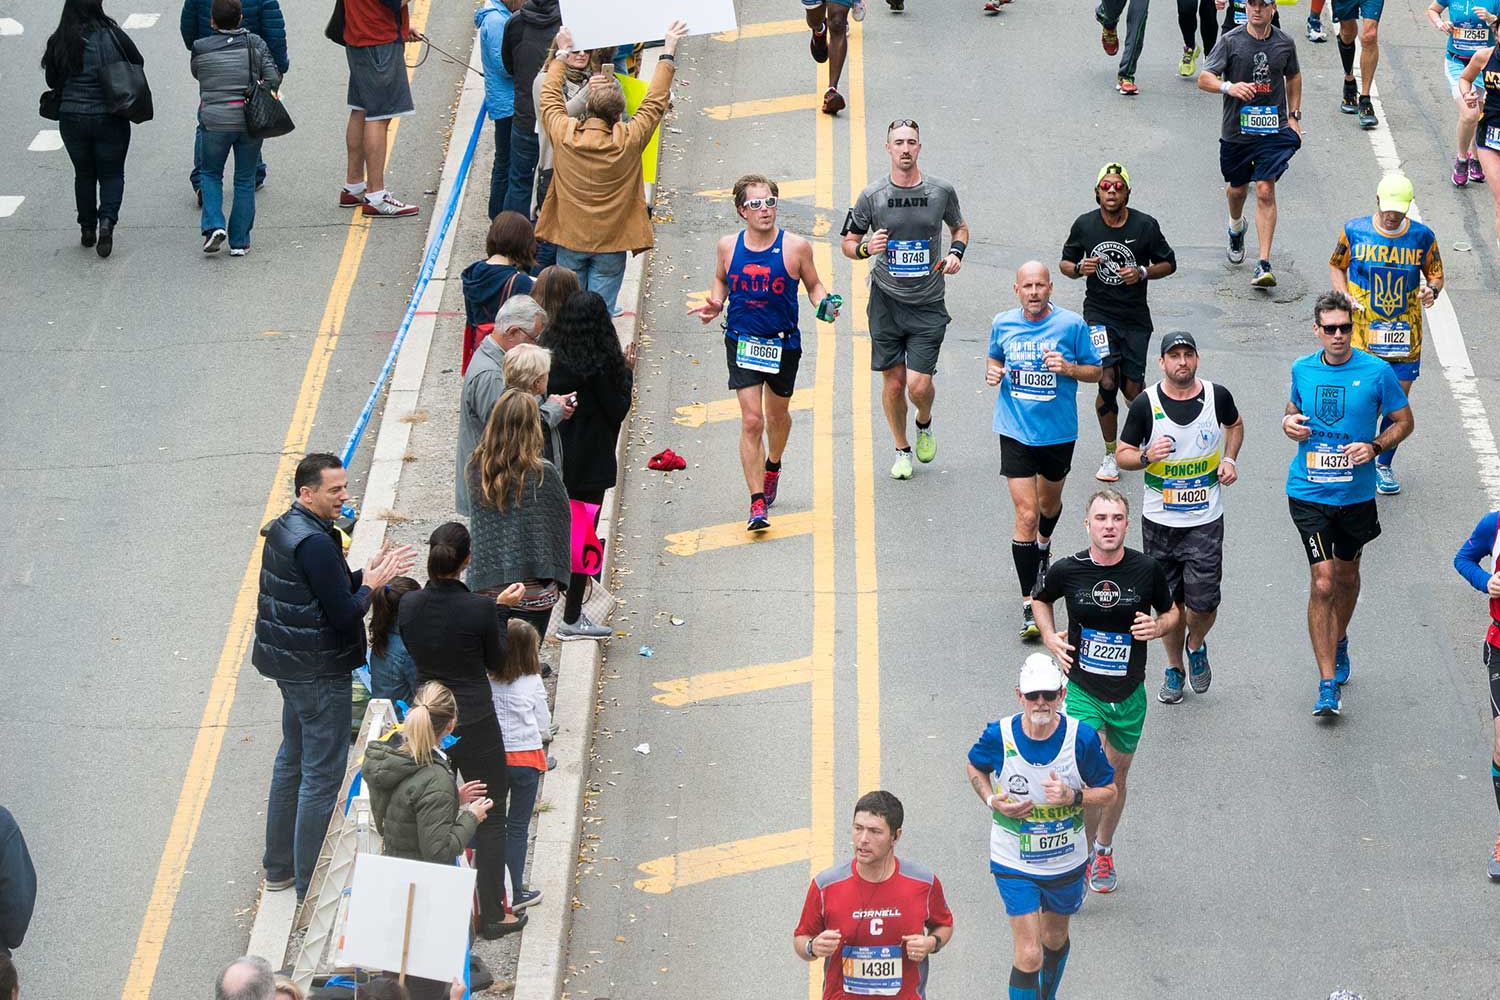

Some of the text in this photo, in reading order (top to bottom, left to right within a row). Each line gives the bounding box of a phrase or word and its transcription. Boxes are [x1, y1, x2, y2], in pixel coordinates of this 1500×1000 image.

[1463, 30, 1486, 40] 12545
[1250, 116, 1278, 127] 50028
[888, 197, 929, 208] SHAUN
[902, 251, 925, 264] 8748
[1355, 244, 1423, 266] UKRAINE
[1384, 332, 1405, 344] 11122
[750, 344, 778, 360] 18660
[1023, 371, 1054, 387] 10382
[1321, 390, 1339, 398] NYC
[1320, 454, 1349, 467] 14373
[1164, 460, 1208, 477] PONCHO
[1177, 489, 1207, 502] 14020
[1094, 590, 1119, 598] BROOKLYN
[1093, 644, 1127, 661] 22274
[1039, 833, 1068, 849] 6775
[852, 910, 902, 919] CORNELL
[869, 918, 884, 936] C
[861, 961, 895, 977] 14381
